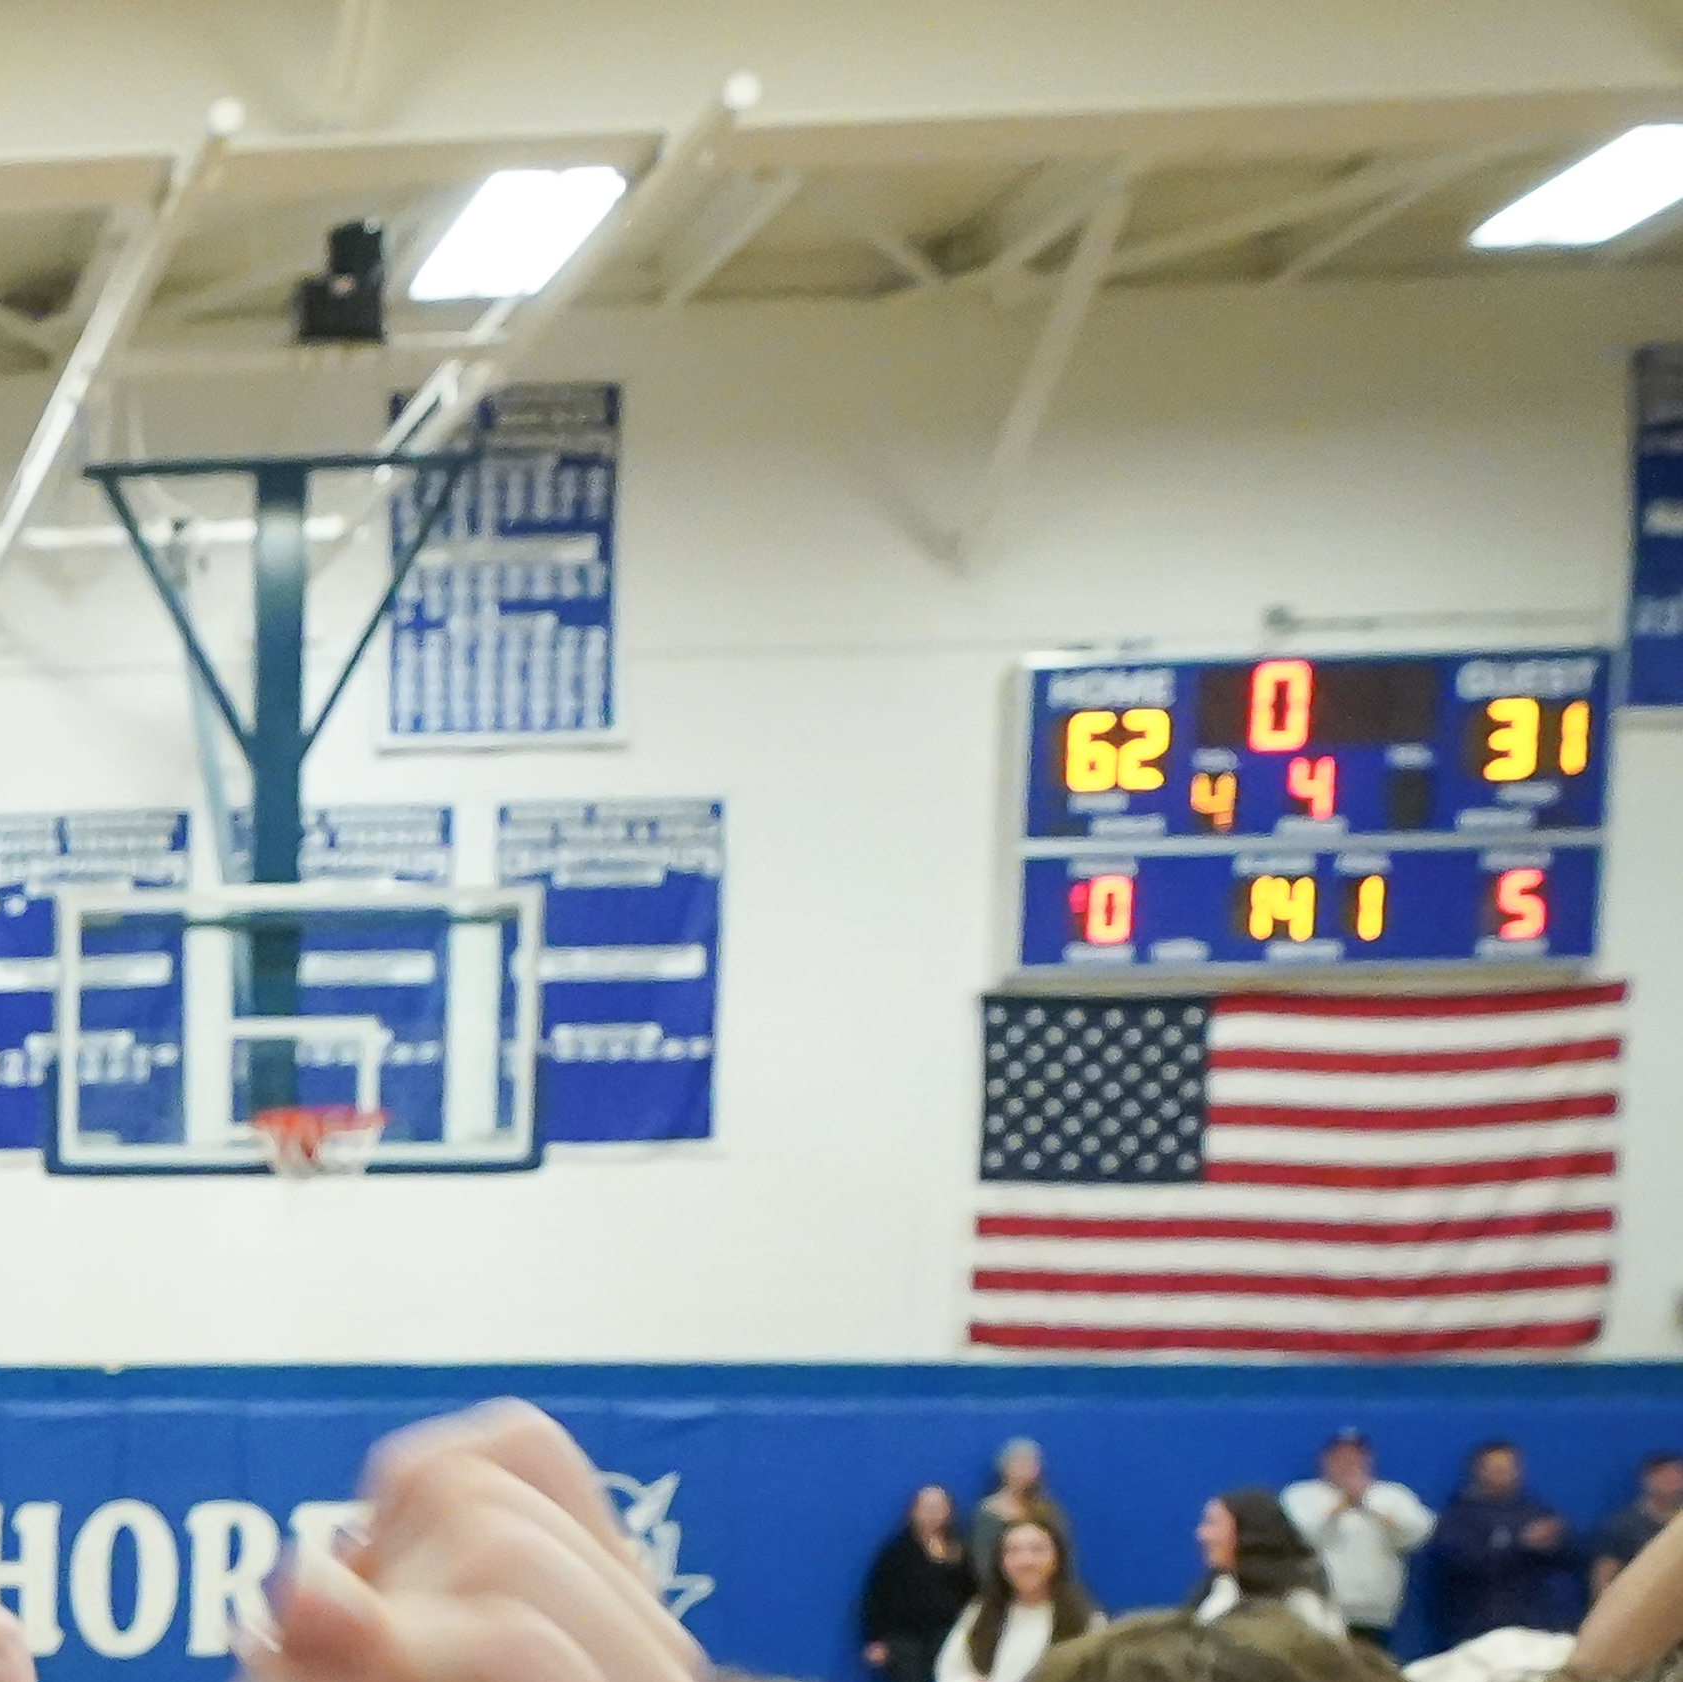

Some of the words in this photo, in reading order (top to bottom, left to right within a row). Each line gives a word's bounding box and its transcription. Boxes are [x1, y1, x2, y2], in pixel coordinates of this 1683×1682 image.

[1248, 658, 1314, 754] 0
[1483, 697, 1590, 781] 31
[1066, 708, 1171, 792] 62
[1190, 772, 1237, 832] 4
[1287, 756, 1336, 822] 4
[1356, 875, 1385, 942] 1
[1496, 868, 1546, 941] 5
